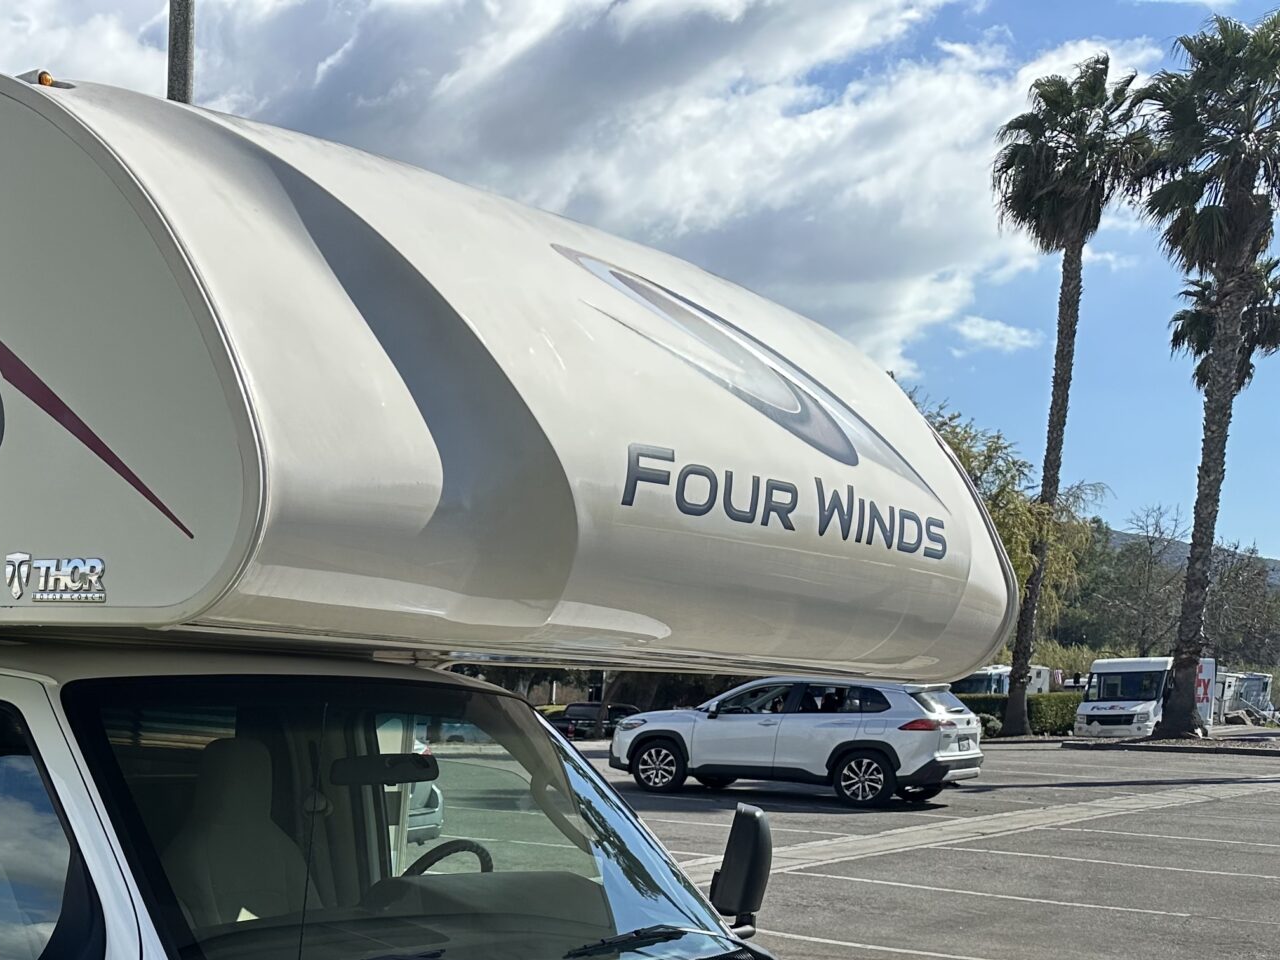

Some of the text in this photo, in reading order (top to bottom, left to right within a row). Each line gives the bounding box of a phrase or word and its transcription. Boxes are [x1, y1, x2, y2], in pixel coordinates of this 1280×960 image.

[621, 442, 947, 560] FOUR WINDS
[32, 558, 105, 592] THOR
[32, 593, 104, 601] MOTOR COACH
[1090, 704, 1127, 712] FedEx
